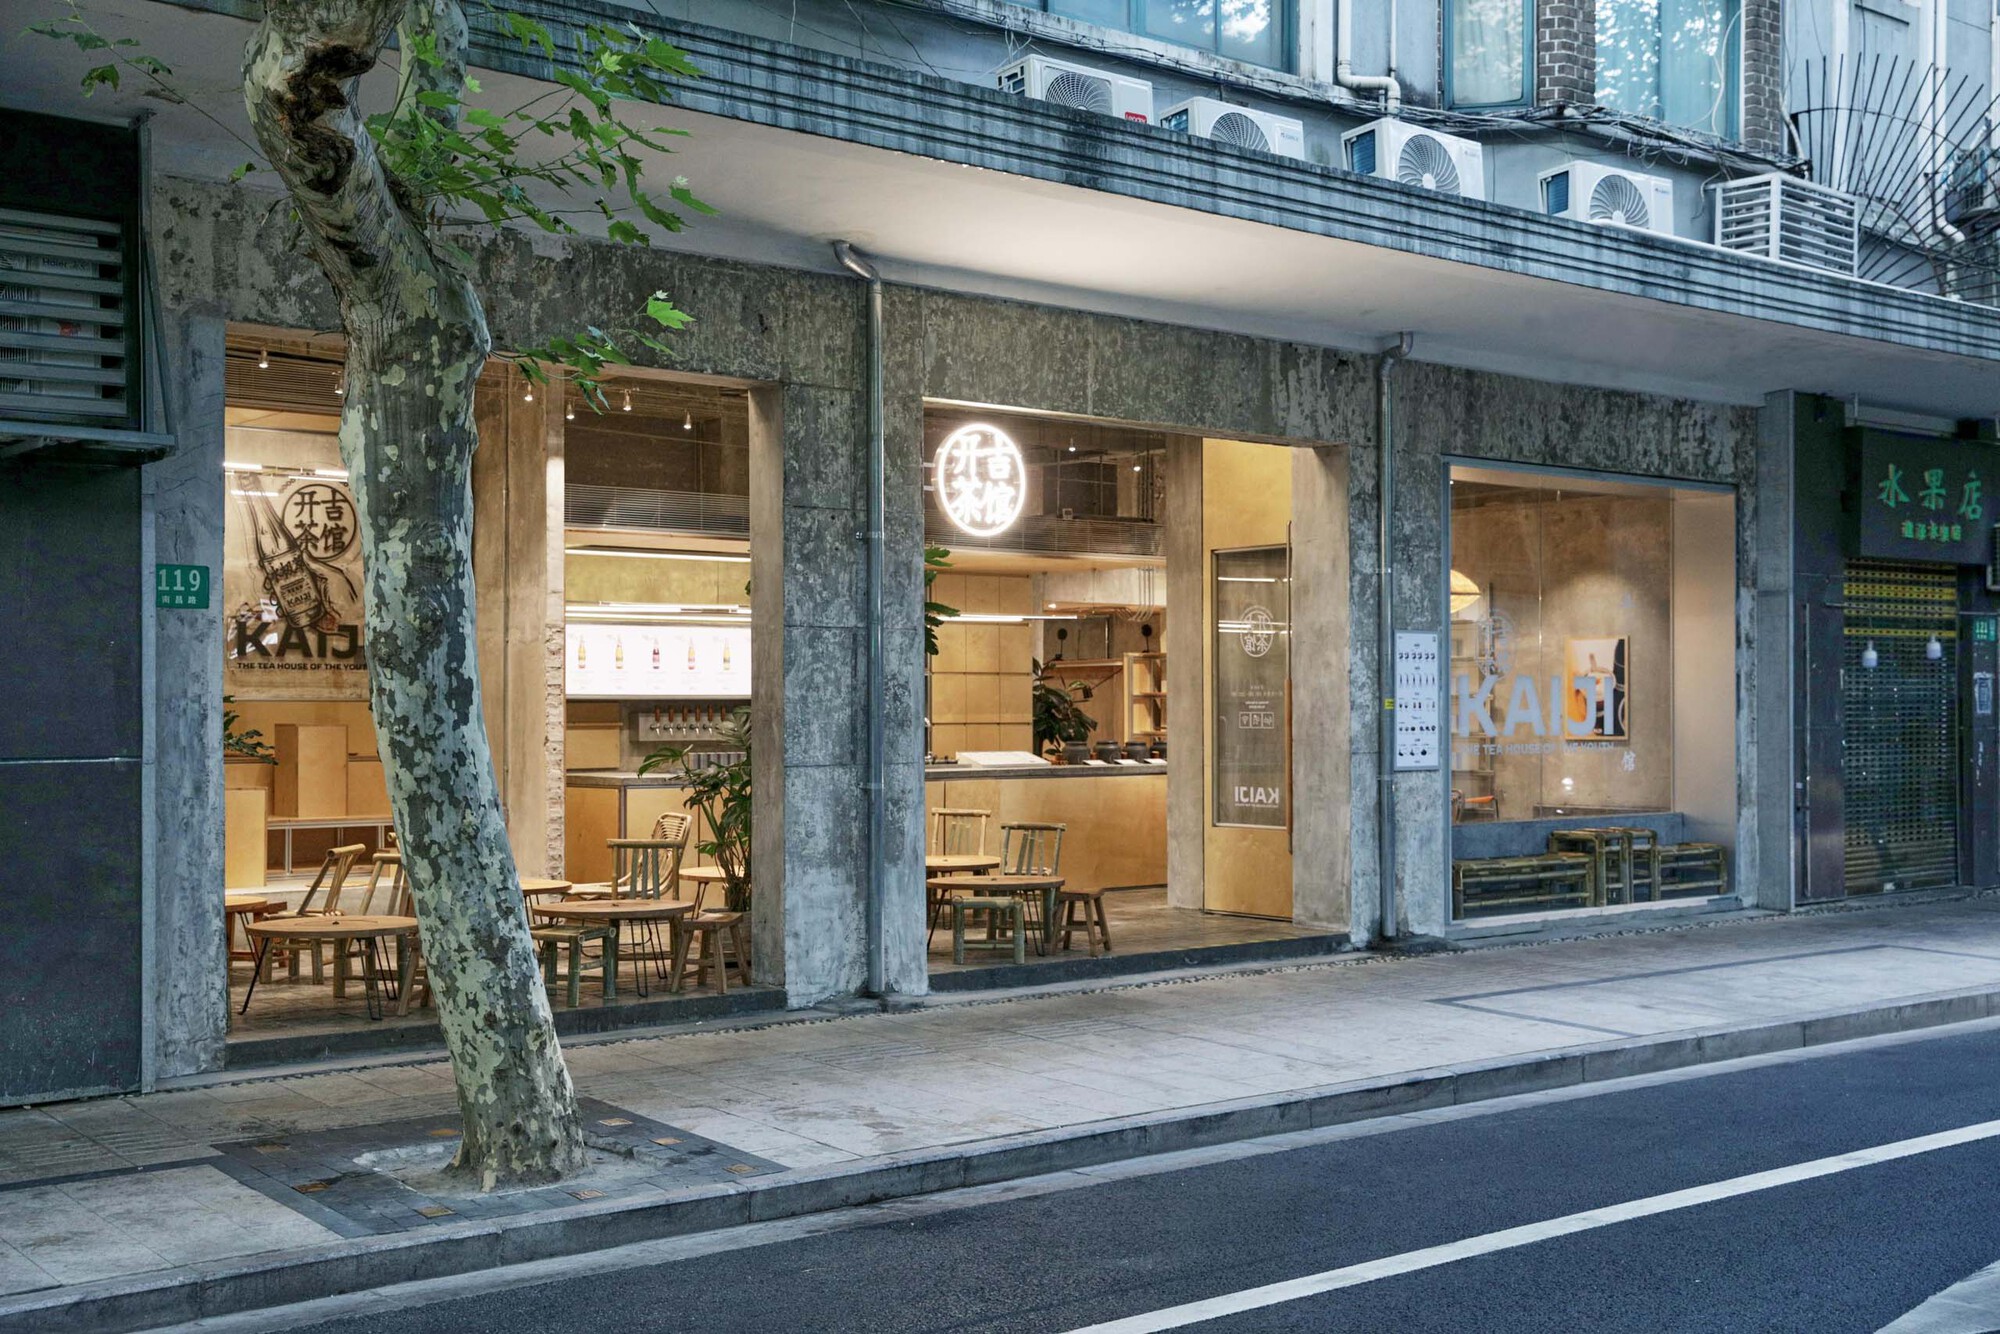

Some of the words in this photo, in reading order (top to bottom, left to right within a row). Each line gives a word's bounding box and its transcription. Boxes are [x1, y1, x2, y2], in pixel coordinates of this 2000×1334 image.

[293, 489, 348, 521] 开吉
[948, 475, 1015, 524] 茶馆
[1878, 463, 1982, 520] 水果店
[294, 520, 348, 552] 茶馆
[157, 569, 200, 591] 119
[236, 621, 359, 659] KAIJ
[237, 662, 255, 670] THE
[257, 662, 276, 670] TEA
[277, 662, 309, 671] HOUSE
[310, 663, 322, 671] OF
[1456, 674, 1614, 738] KAIJI
[1483, 743, 1503, 755] TEA
